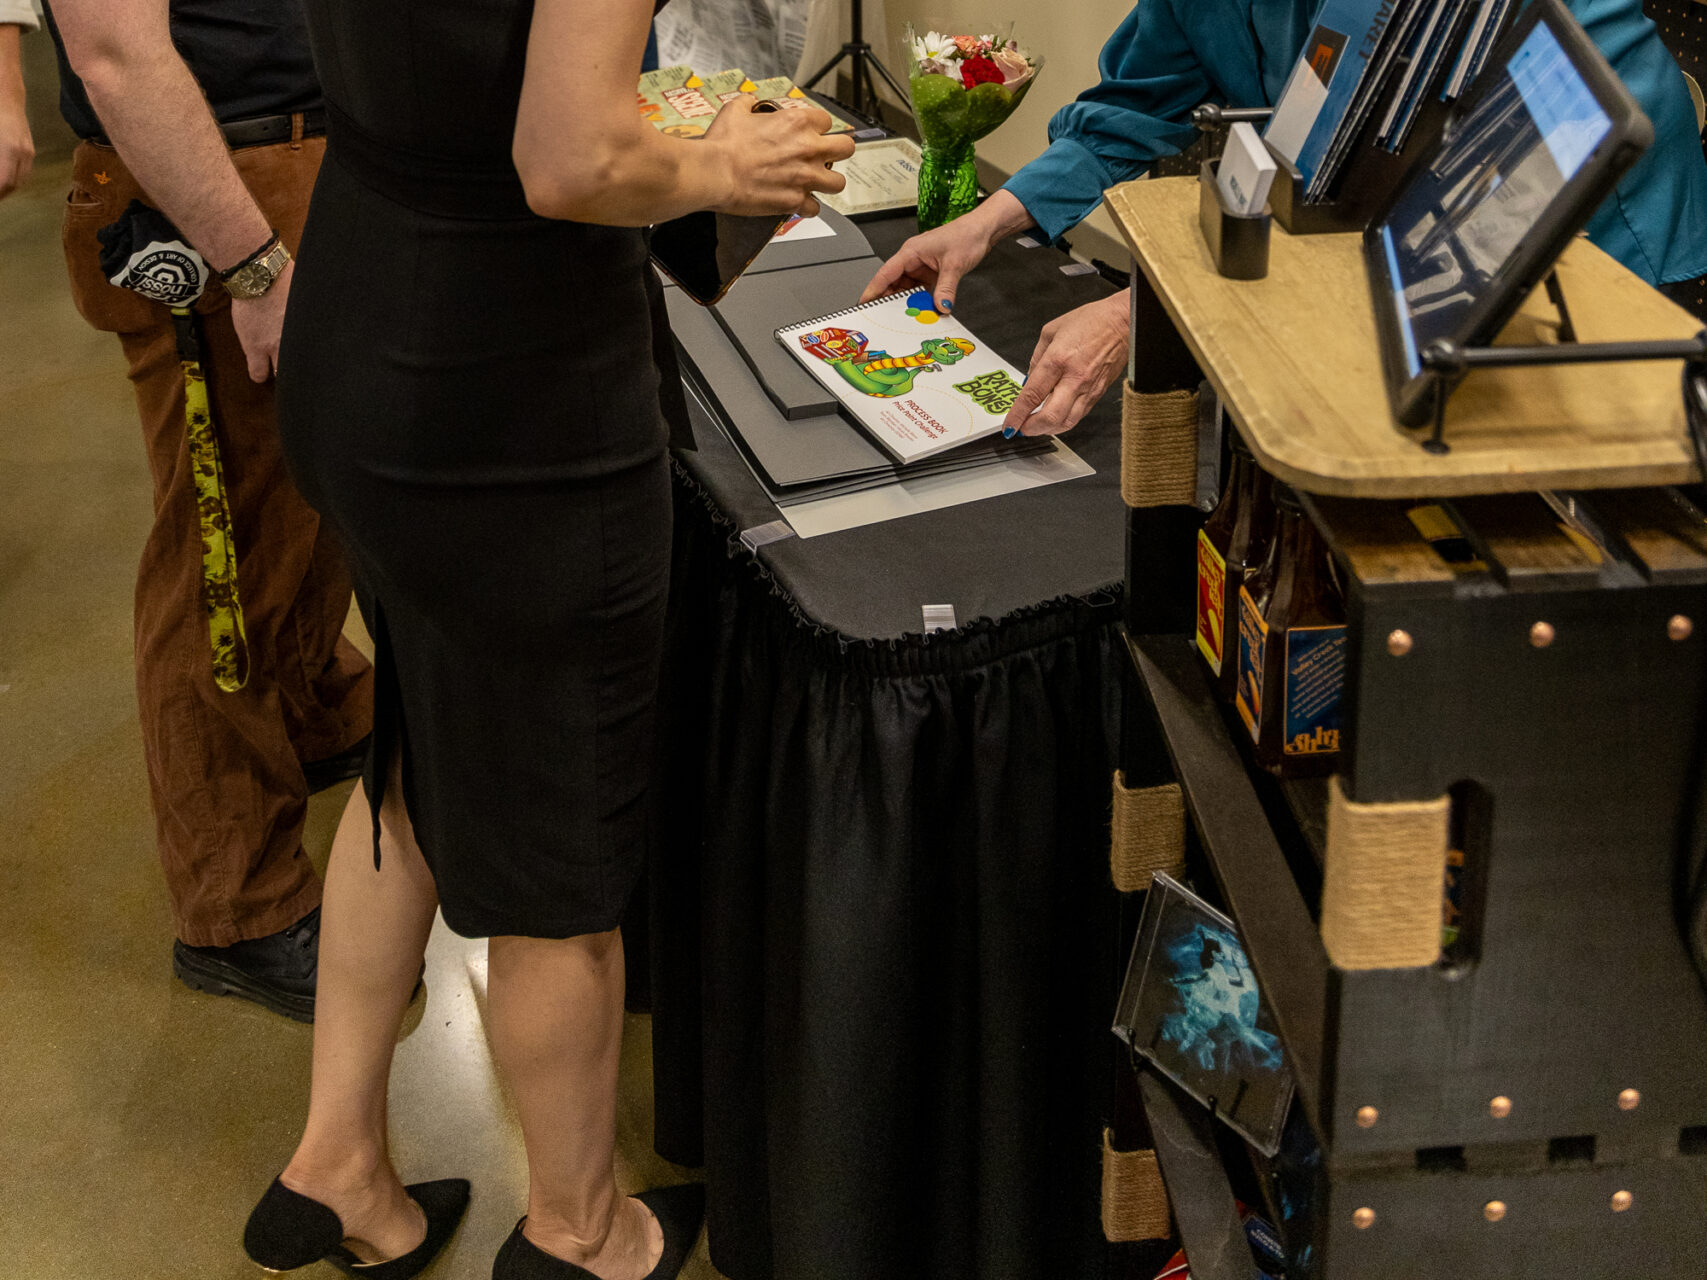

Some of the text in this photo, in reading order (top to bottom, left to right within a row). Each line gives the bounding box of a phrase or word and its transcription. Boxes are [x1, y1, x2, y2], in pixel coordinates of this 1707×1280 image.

[138, 255, 158, 271] DESIGN
[176, 255, 185, 264] OF
[184, 260, 198, 283] COLLEGE
[904, 400, 929, 421] PROCESS
[928, 419, 948, 435] BOOK
